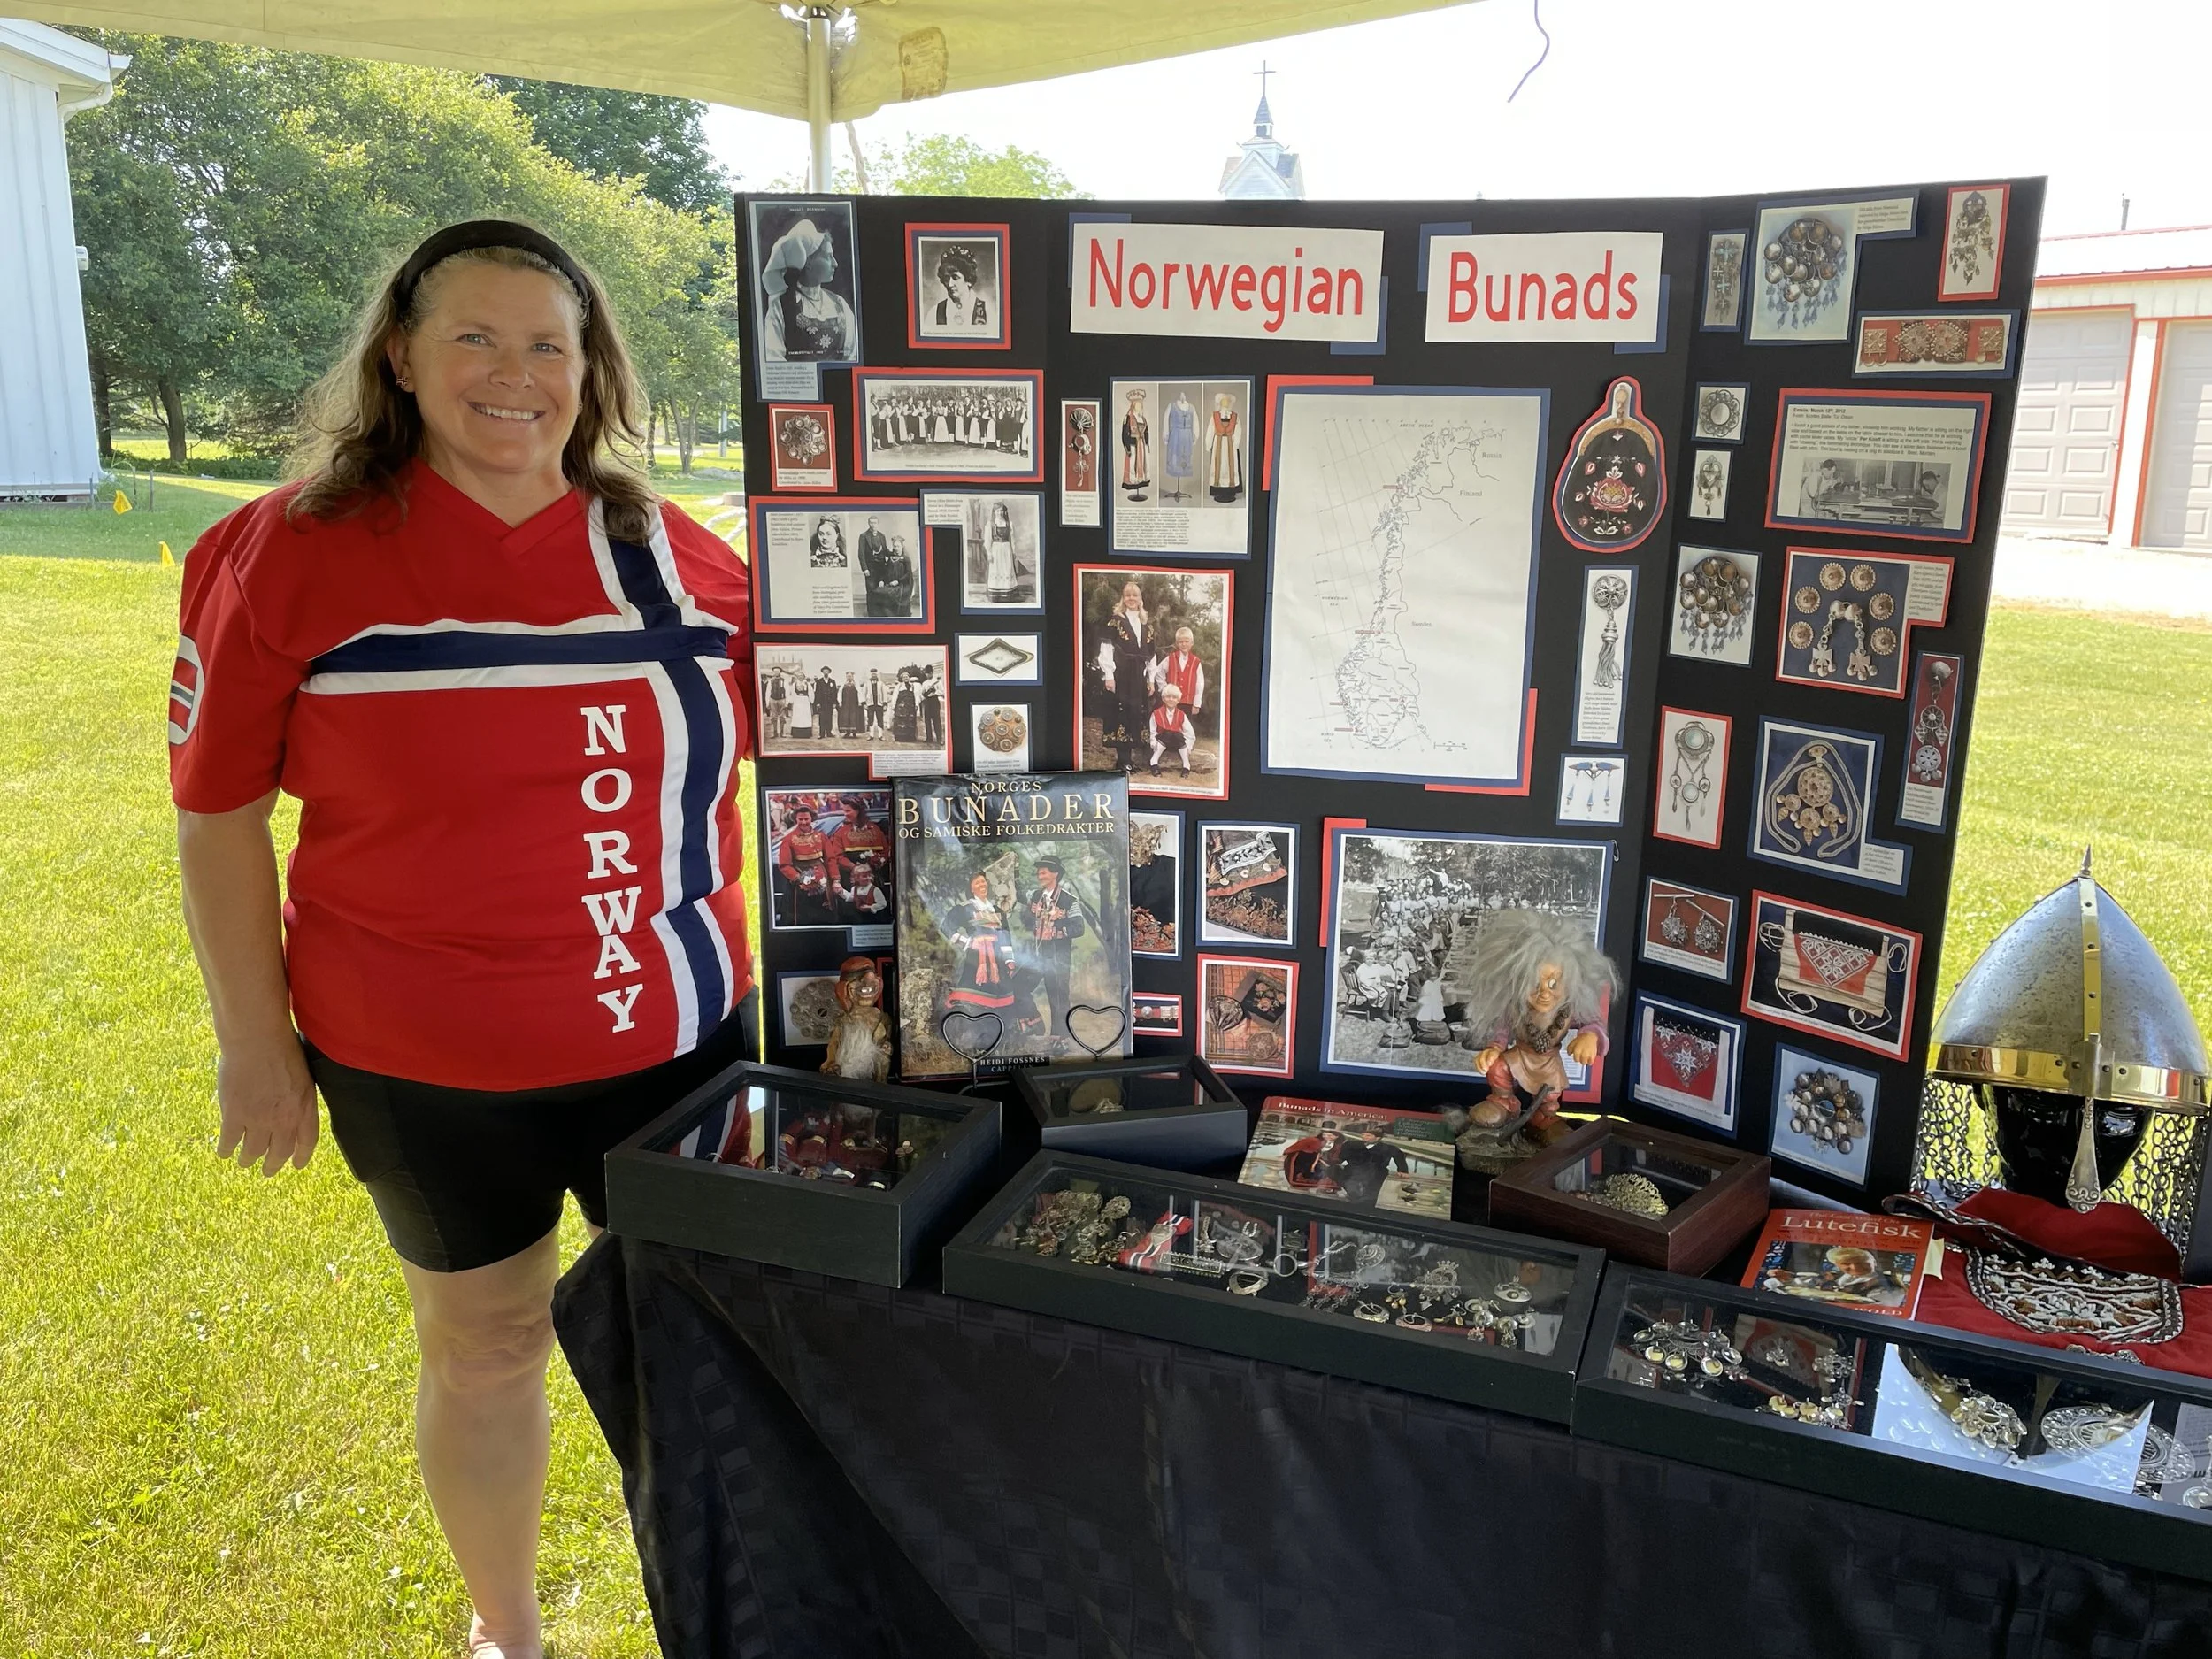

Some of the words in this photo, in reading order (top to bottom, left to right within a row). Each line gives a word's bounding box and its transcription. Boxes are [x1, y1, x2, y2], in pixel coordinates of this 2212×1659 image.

[1089, 238, 1363, 332] Norwegian
[1448, 250, 1639, 323] Bunads
[971, 780, 1041, 795] NORGES
[898, 793, 1115, 825] BUNADER
[898, 827, 919, 839] OG
[924, 825, 991, 839] SAMISKE
[996, 822, 1115, 836] FOLKEDRAKTER
[580, 703, 644, 1033] NORWAY
[1278, 1102, 1321, 1112] Bunads
[1780, 1216, 1923, 1239] Lutefisk
